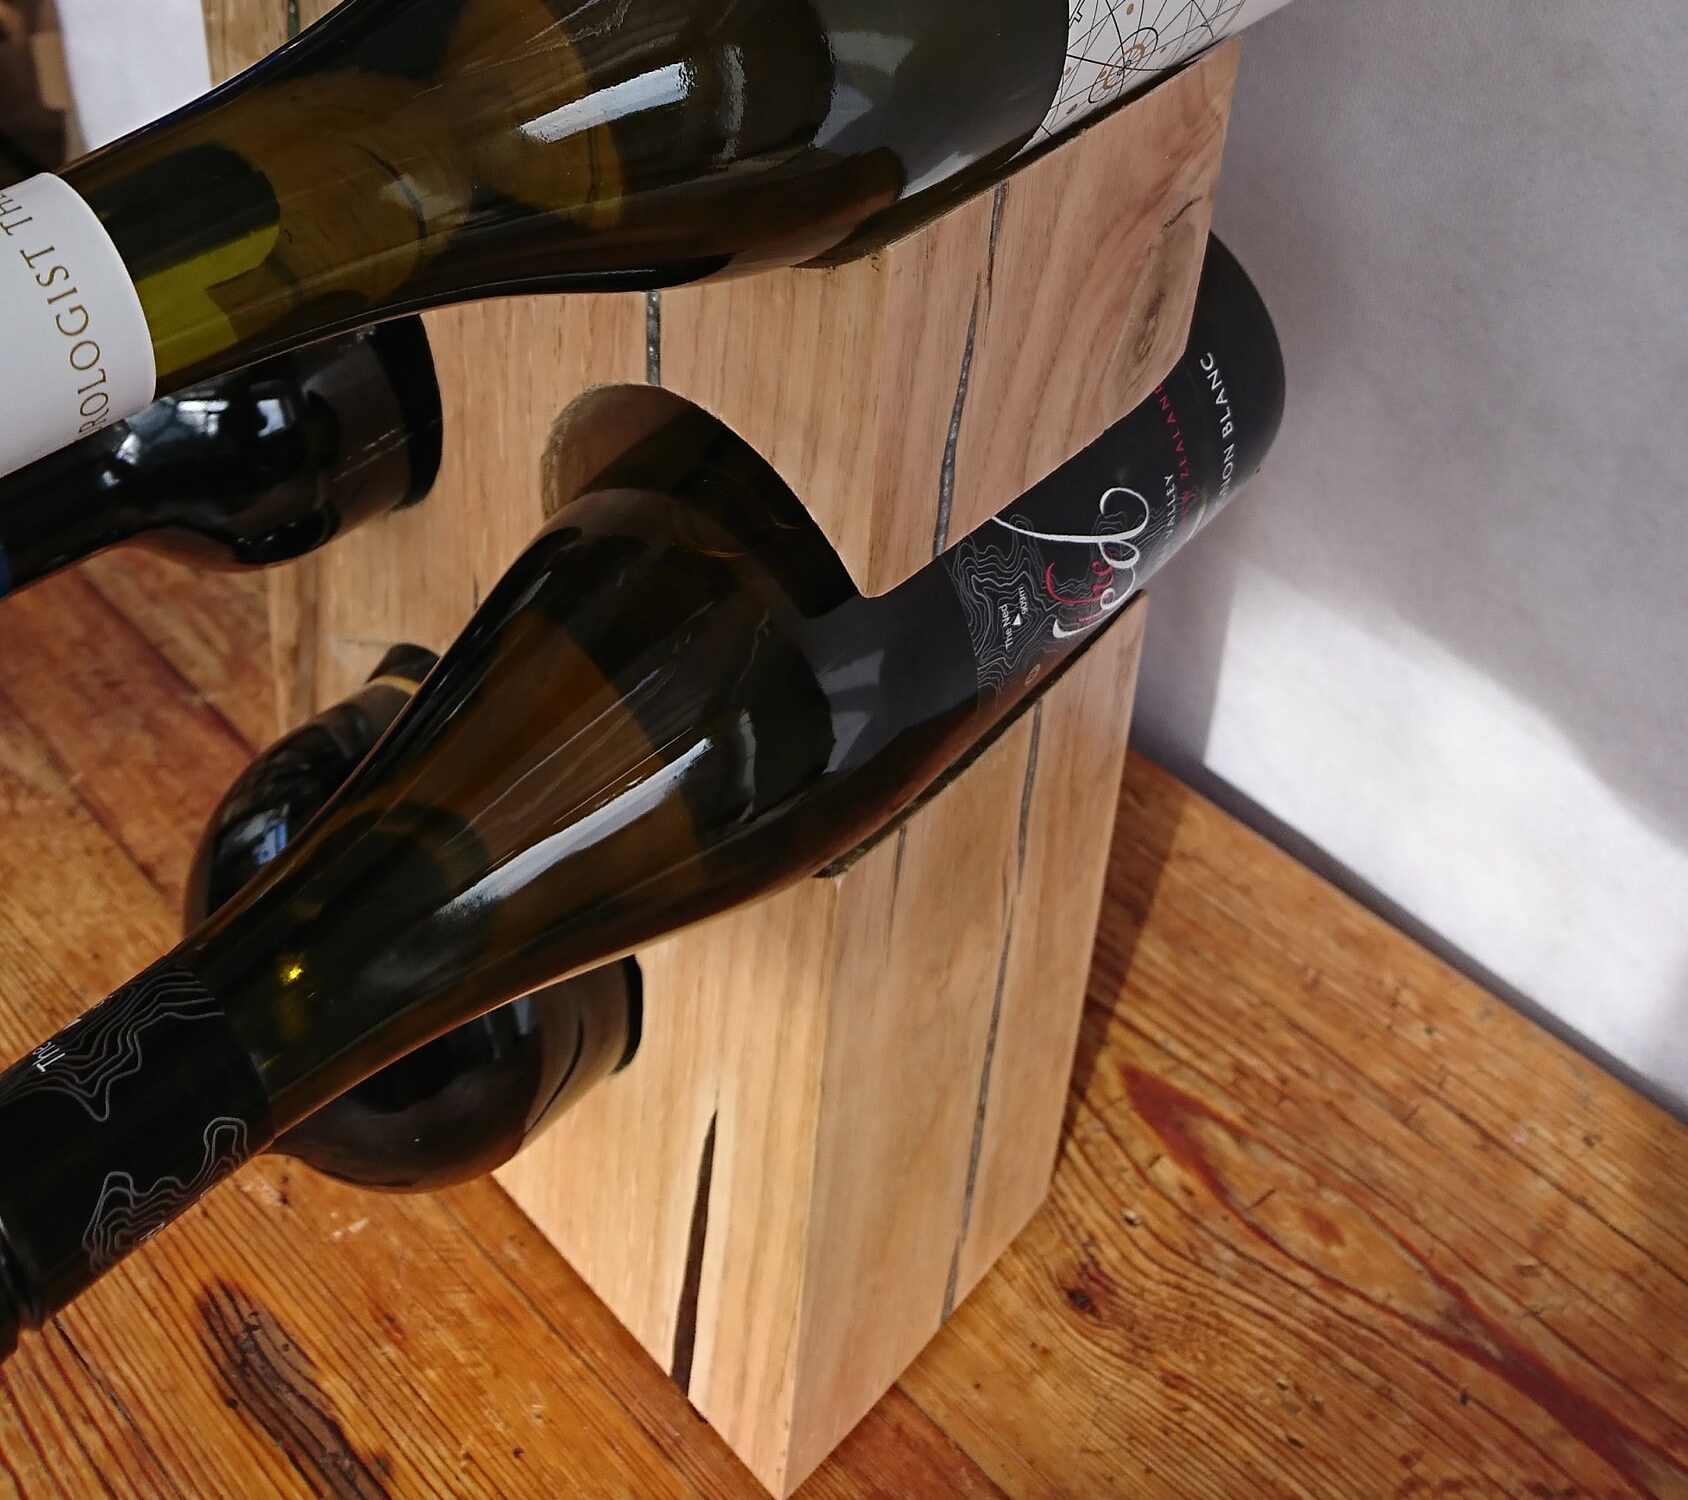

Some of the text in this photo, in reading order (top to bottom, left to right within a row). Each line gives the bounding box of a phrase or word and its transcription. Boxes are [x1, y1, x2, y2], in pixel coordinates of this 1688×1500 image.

[1200, 352, 1235, 439] BLANC
[1164, 474, 1177, 539] VALLEY
[999, 604, 1014, 650] The Ned
[32, 1042, 66, 1073] The
